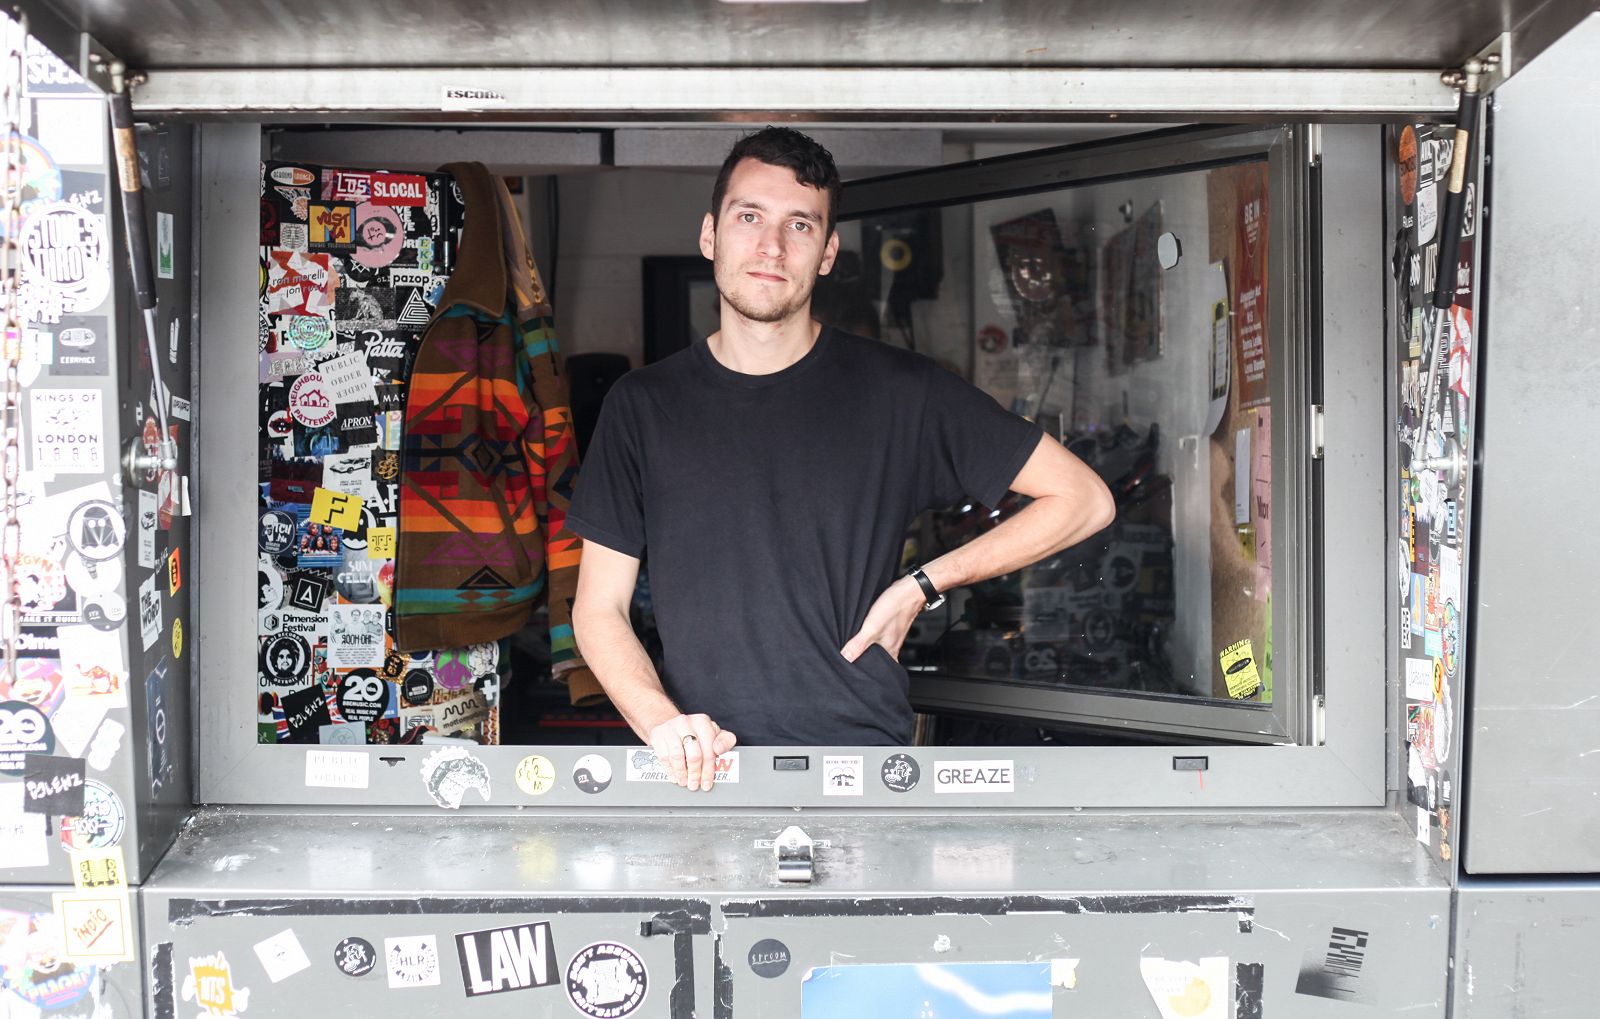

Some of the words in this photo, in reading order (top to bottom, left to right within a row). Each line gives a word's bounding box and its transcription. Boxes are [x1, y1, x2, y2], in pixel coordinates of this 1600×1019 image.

[373, 181, 423, 198] SLOCAL
[361, 329, 406, 359] Patta
[325, 356, 360, 374] PUBLIC
[36, 394, 74, 402] KINGS
[82, 394, 97, 402] OF
[291, 374, 324, 407] NEIGHBOU
[295, 409, 335, 426] PATTERNS
[341, 416, 373, 429] APRON
[37, 434, 98, 443] LONDON
[300, 585, 313, 604] A
[283, 613, 329, 622] Dimension
[282, 623, 316, 632] Festival
[343, 675, 384, 702] 20
[937, 768, 1011, 784] GREAZE
[399, 955, 425, 967] HLR
[463, 924, 547, 994] LAW
